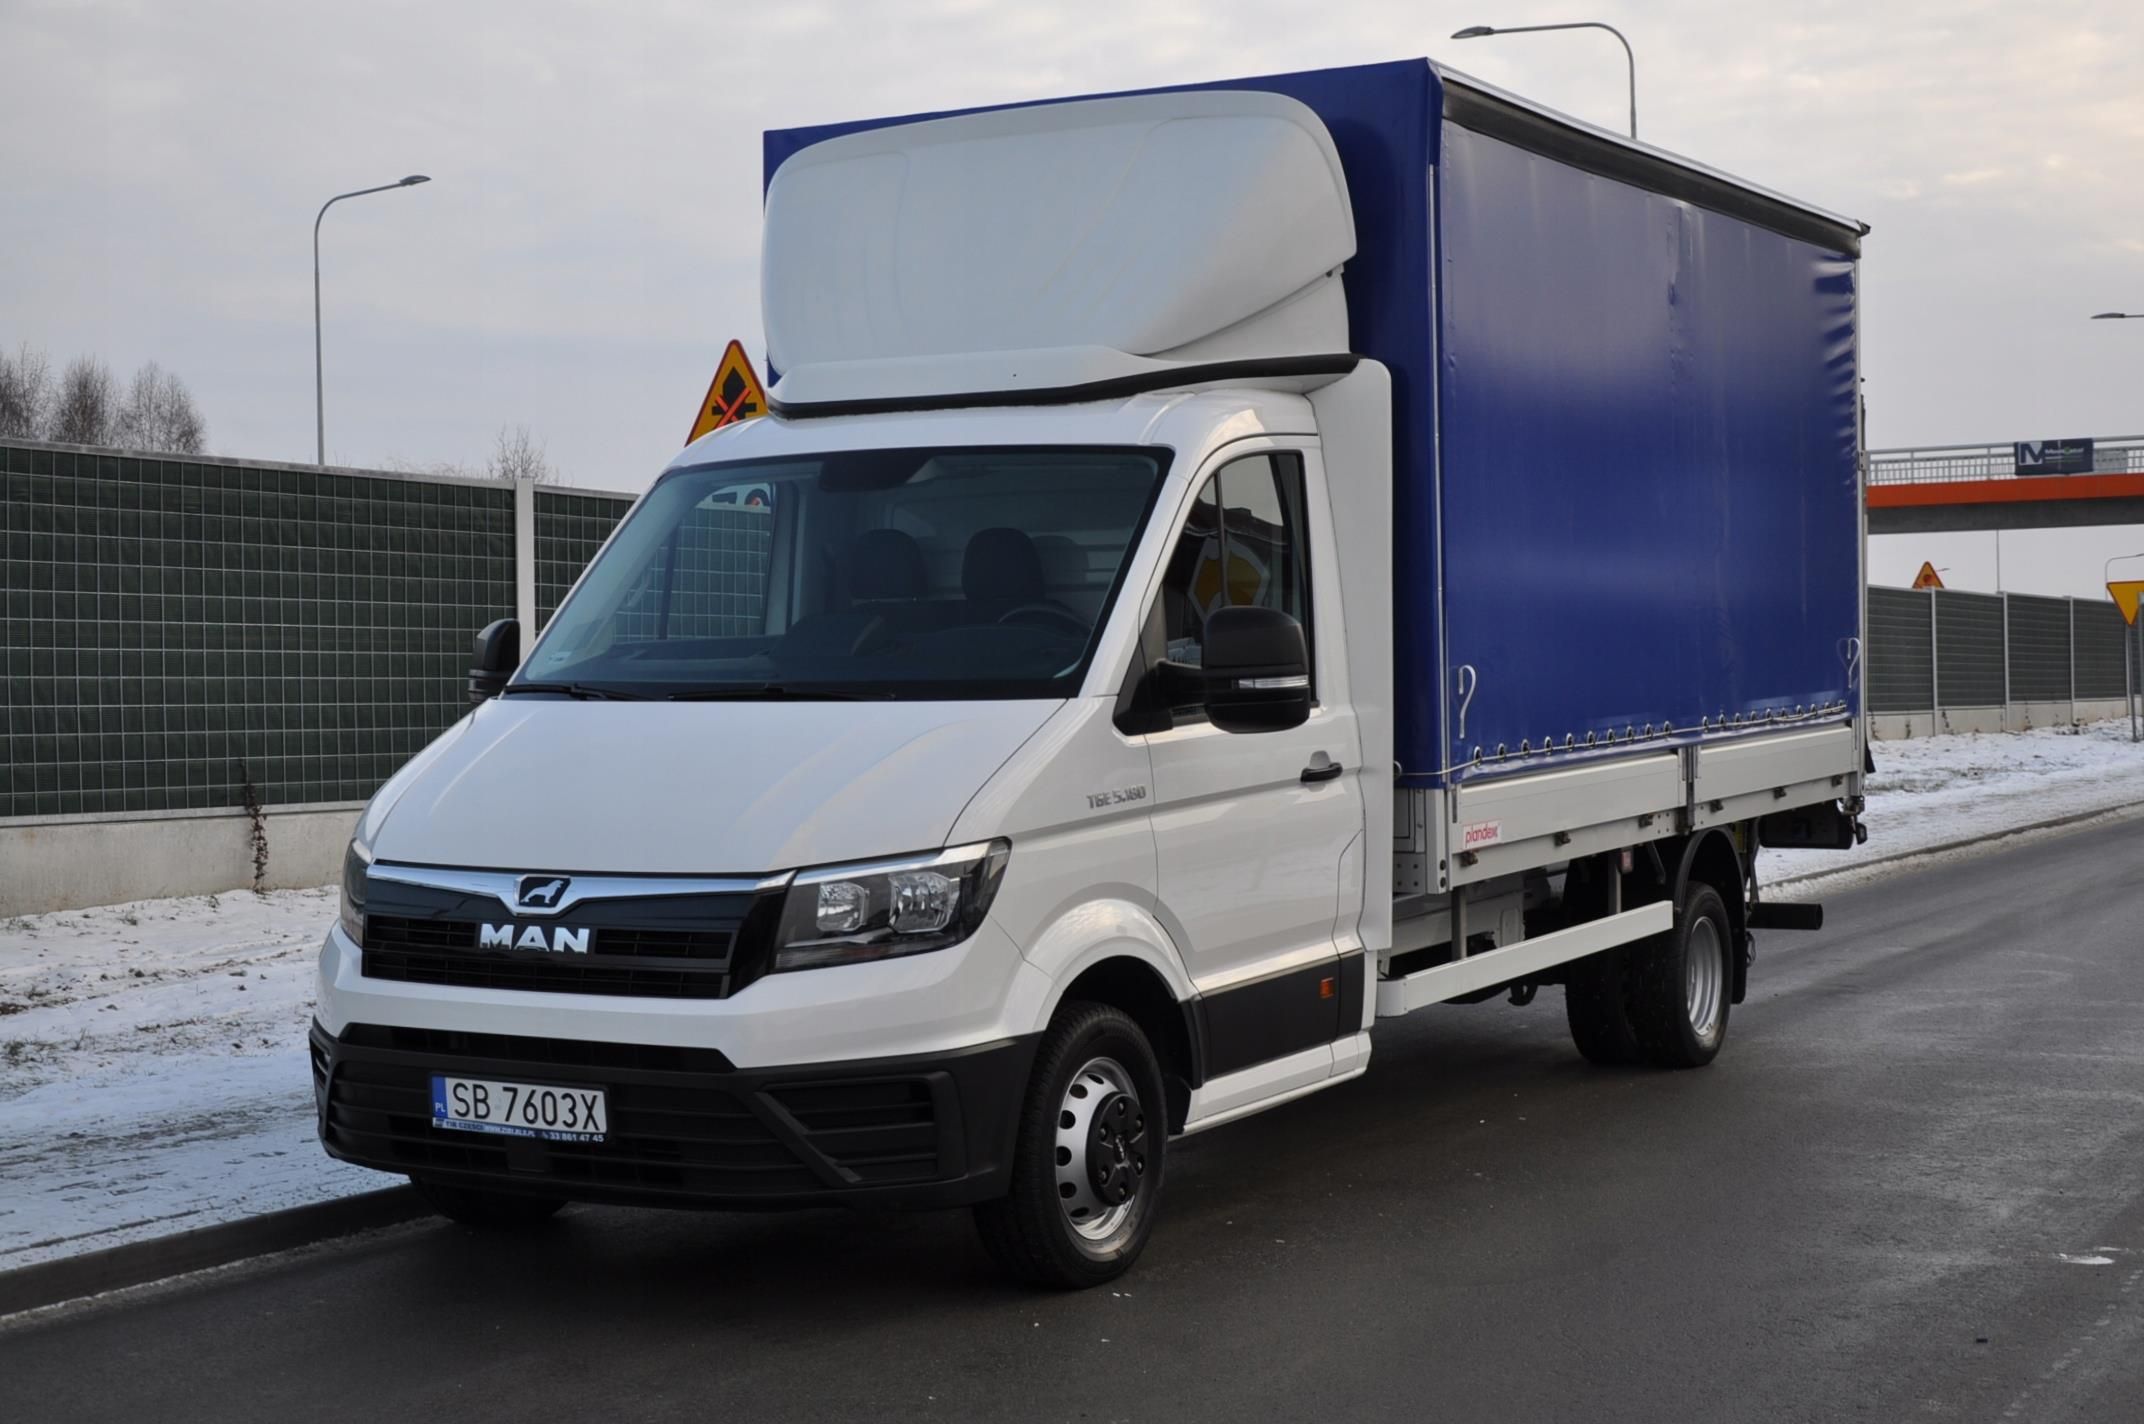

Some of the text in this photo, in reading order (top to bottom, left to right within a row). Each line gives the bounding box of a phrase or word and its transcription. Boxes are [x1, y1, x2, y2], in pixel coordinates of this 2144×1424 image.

[480, 923, 590, 954] MAN
[434, 1102, 446, 1113] PL
[452, 1082, 600, 1131] SB 7603X
[579, 1133, 590, 1143] 47
[592, 1133, 604, 1143] 45
